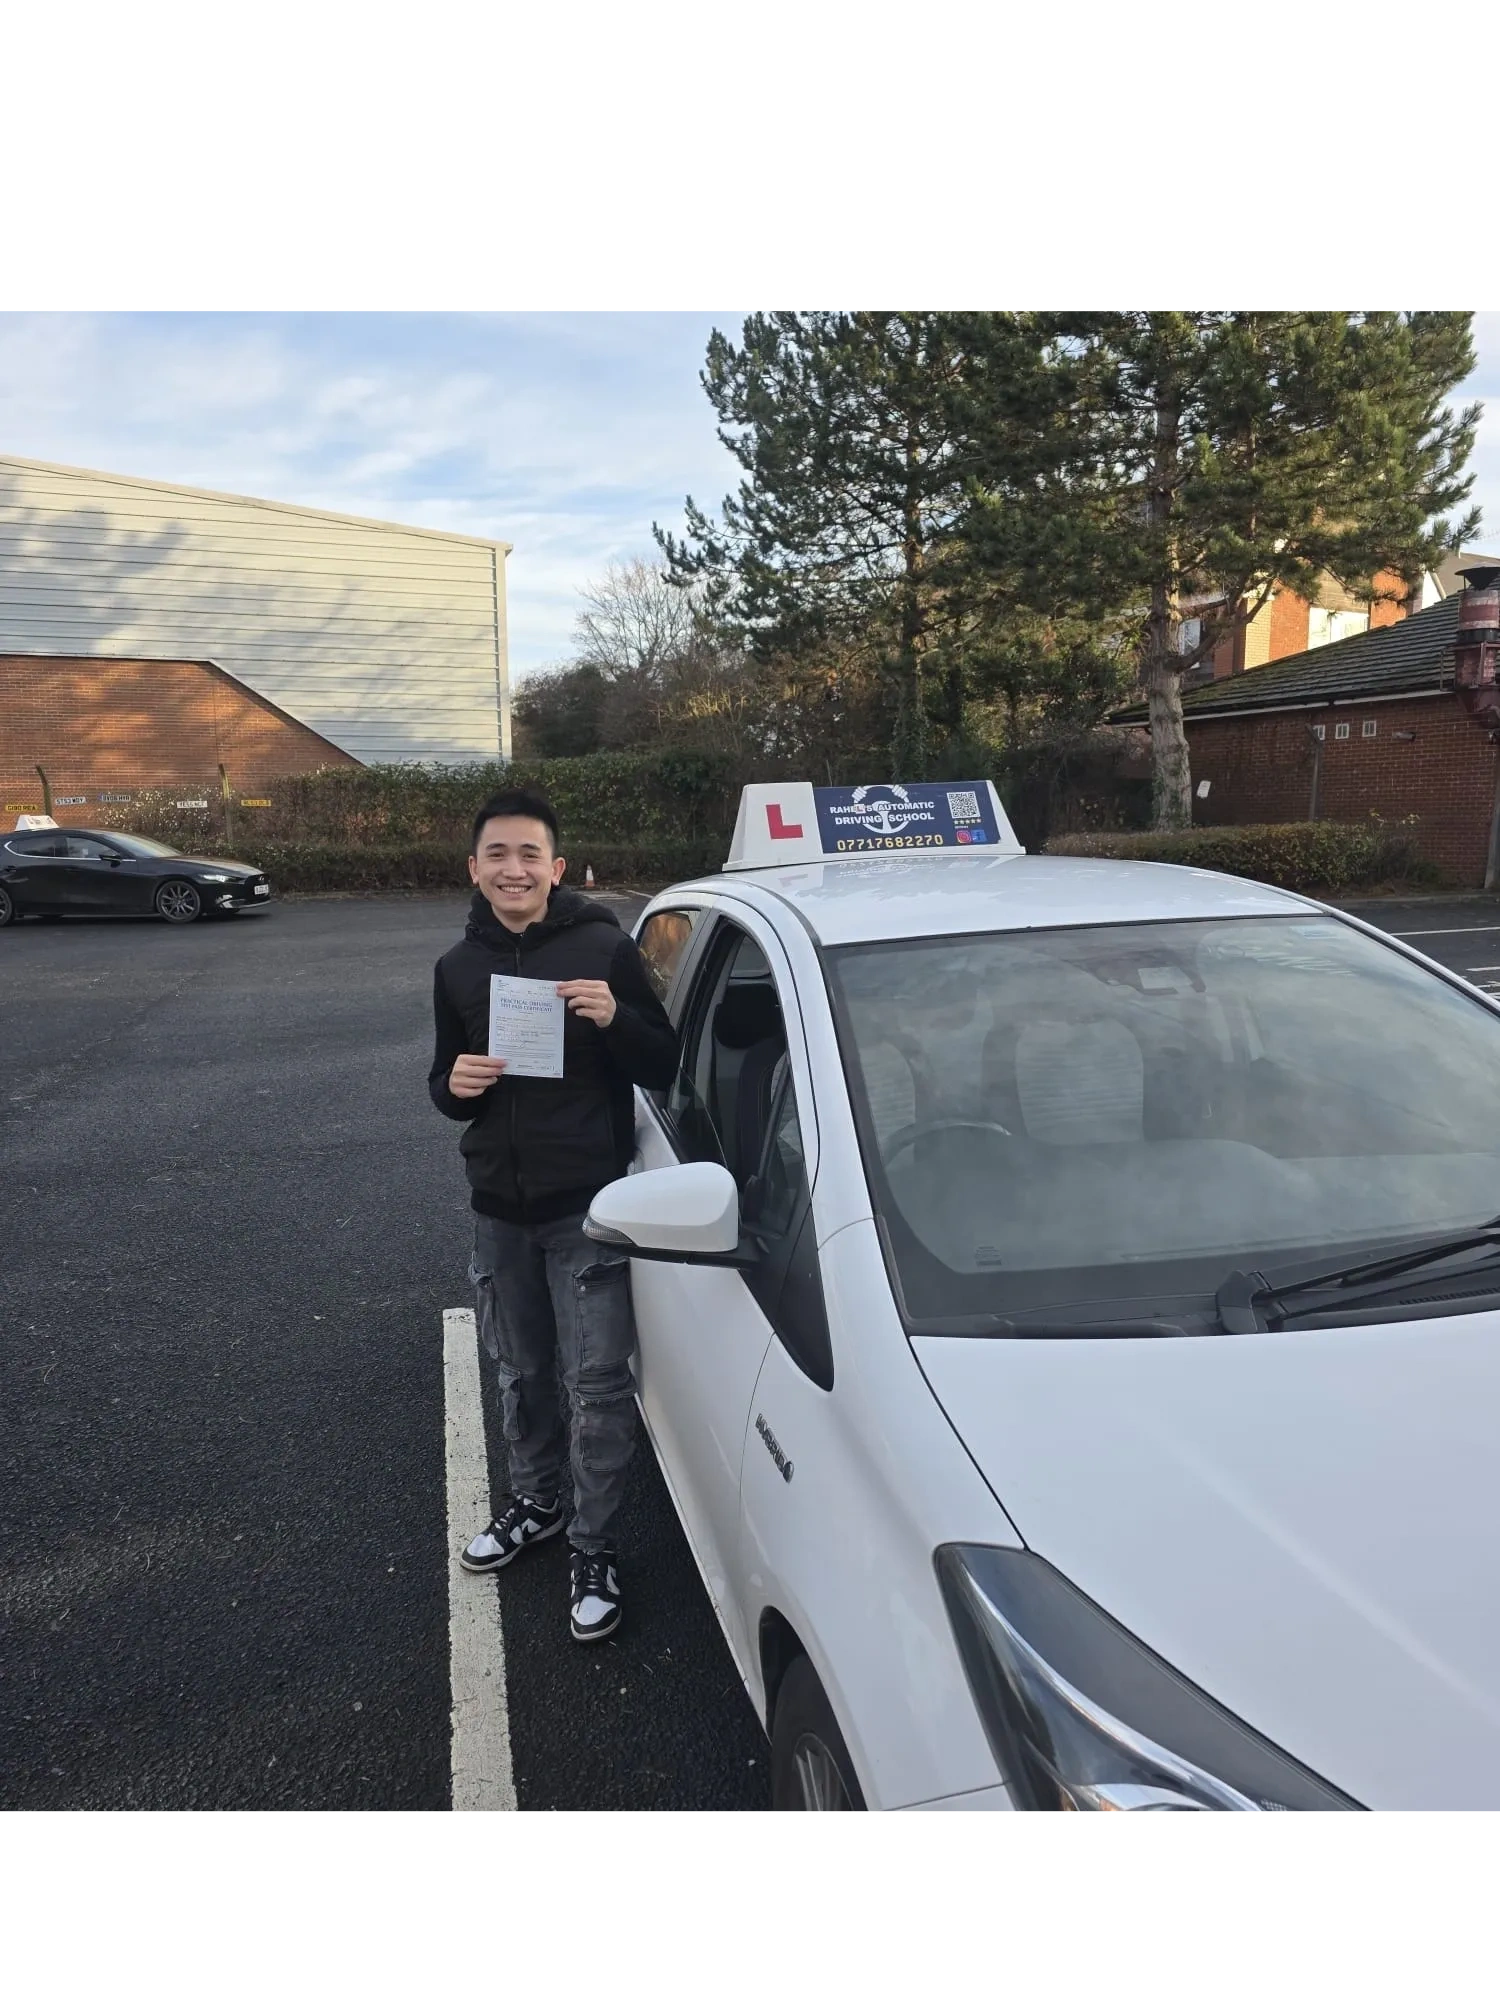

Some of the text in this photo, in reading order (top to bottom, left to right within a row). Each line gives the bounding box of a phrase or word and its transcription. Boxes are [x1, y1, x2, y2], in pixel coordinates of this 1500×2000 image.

[878, 801, 935, 811] AUTOMATIC
[765, 804, 804, 840] L
[834, 812, 935, 825] DRIVING SCHOOL
[837, 834, 944, 851] 07717682270
